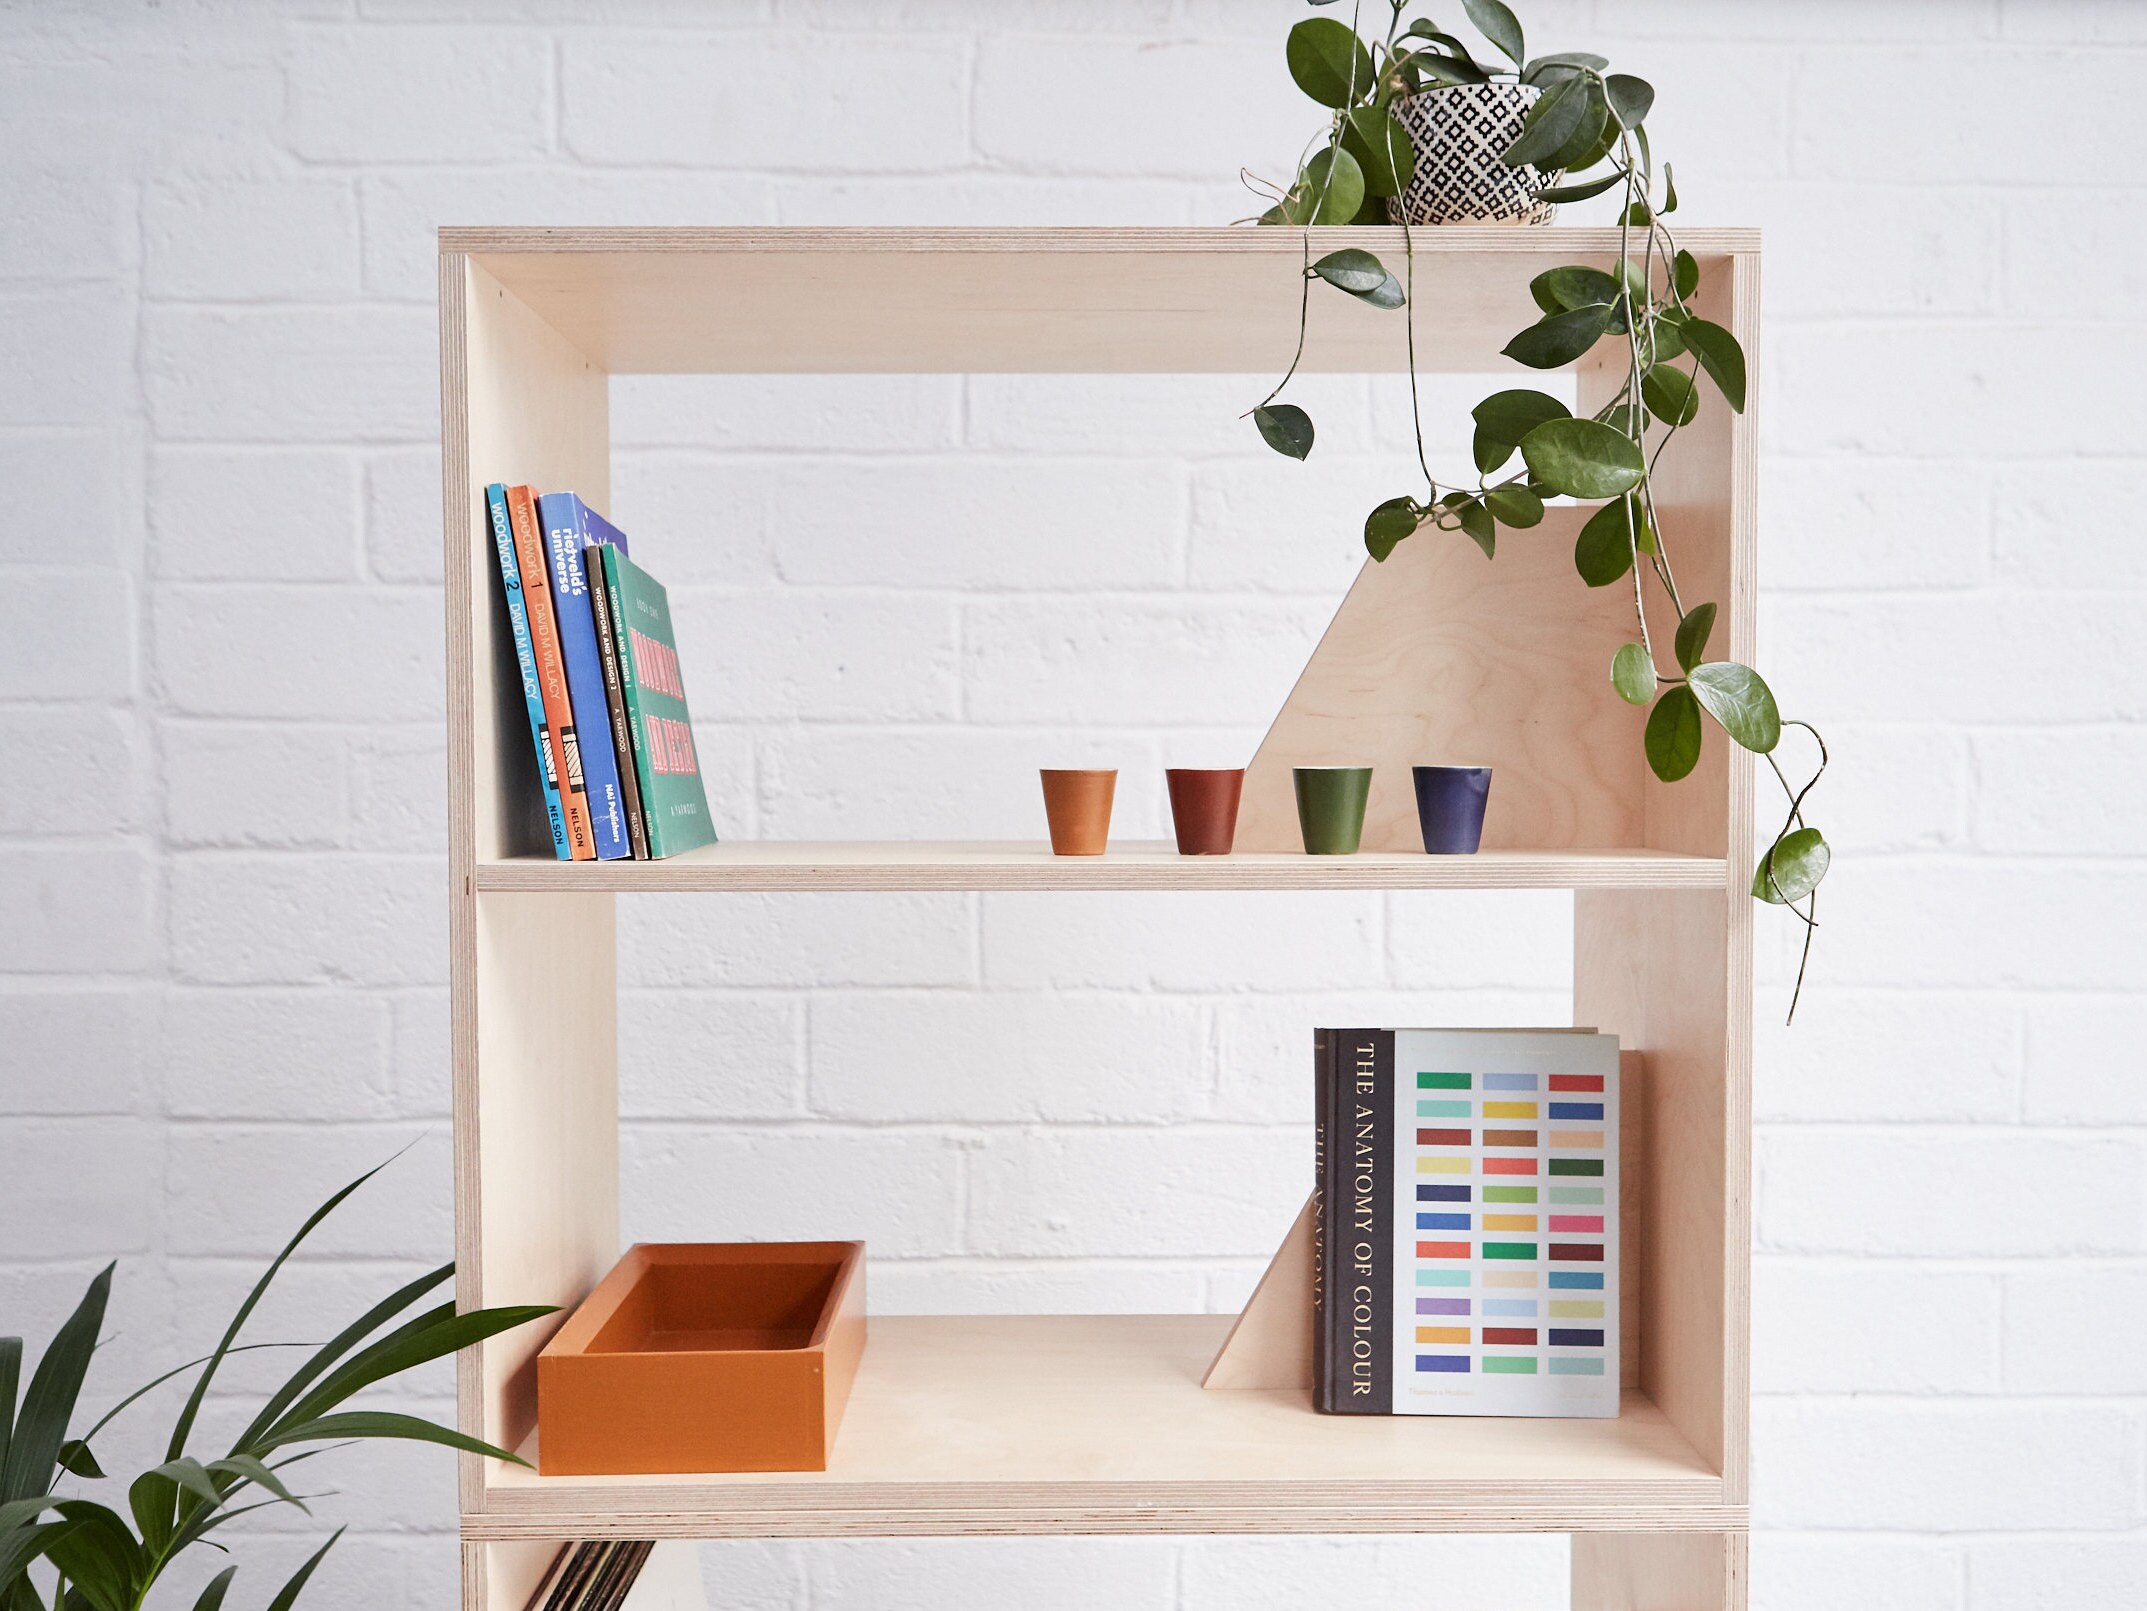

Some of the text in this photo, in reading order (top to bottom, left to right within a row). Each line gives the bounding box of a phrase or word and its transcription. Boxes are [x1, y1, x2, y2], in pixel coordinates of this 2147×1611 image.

[491, 502, 519, 591] woodwork 2
[517, 502, 541, 579] woodwork
[551, 529, 570, 593] universe
[563, 528, 587, 596] rietveld's
[595, 587, 608, 636] WOODWORK
[610, 585, 623, 633] WOODWORK
[509, 603, 537, 700] DAVID M WILLACY
[534, 603, 561, 699] DAVID M WILLACY
[603, 637, 611, 654] AND
[617, 635, 626, 652] AND
[606, 656, 616, 684] DESIGN
[620, 655, 630, 682] DESIGN
[615, 717, 626, 753] YARWOOD
[630, 716, 641, 751] YARWOOD
[549, 805, 563, 845] NELSON
[570, 808, 584, 847] NELSON
[607, 802, 620, 843] Publishers
[631, 812, 640, 838] NELSON
[645, 810, 653, 837] NELSON
[1315, 1124, 1325, 1174] THE
[1352, 1043, 1374, 1395] THE ANATOMY OF COLOUR
